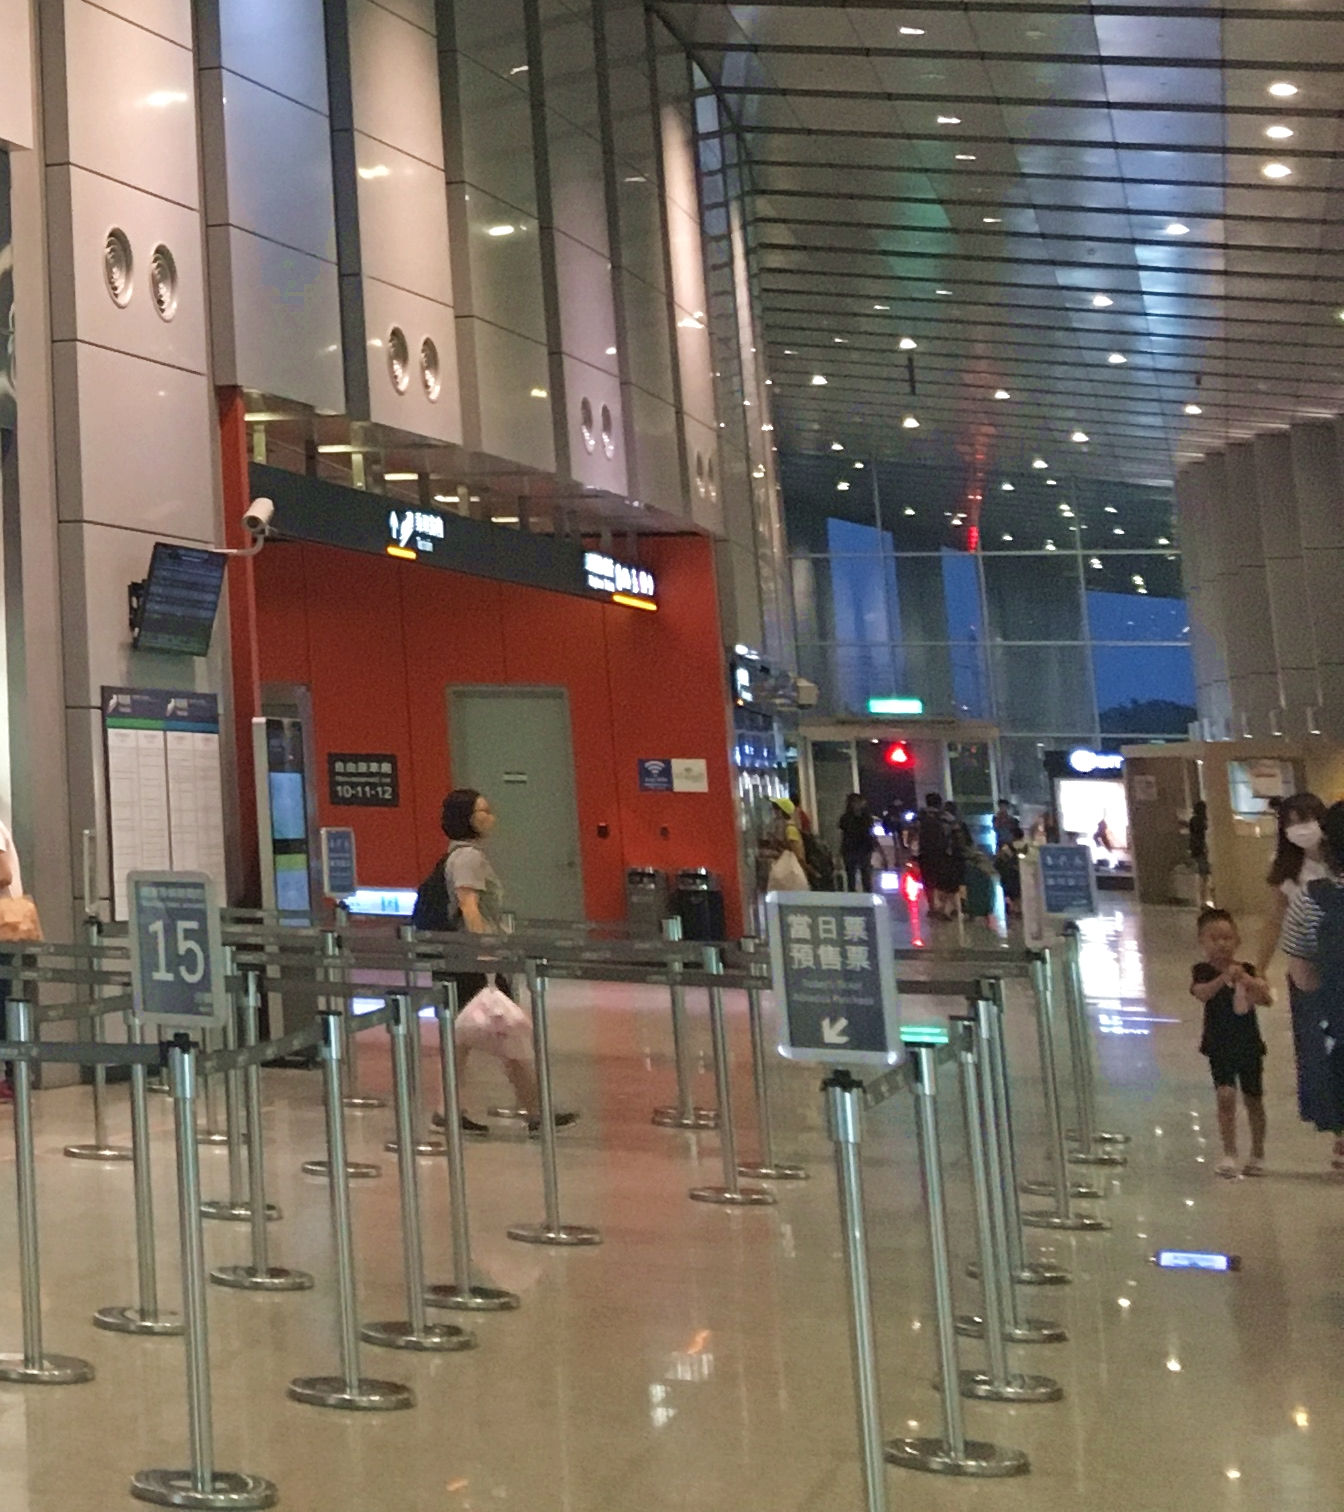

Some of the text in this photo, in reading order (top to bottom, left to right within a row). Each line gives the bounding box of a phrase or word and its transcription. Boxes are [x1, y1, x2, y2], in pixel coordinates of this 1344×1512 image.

[336, 786, 392, 798] 10-11-12
[788, 914, 868, 941] 當日票
[148, 920, 204, 983] 15
[790, 944, 871, 971] 預售票
